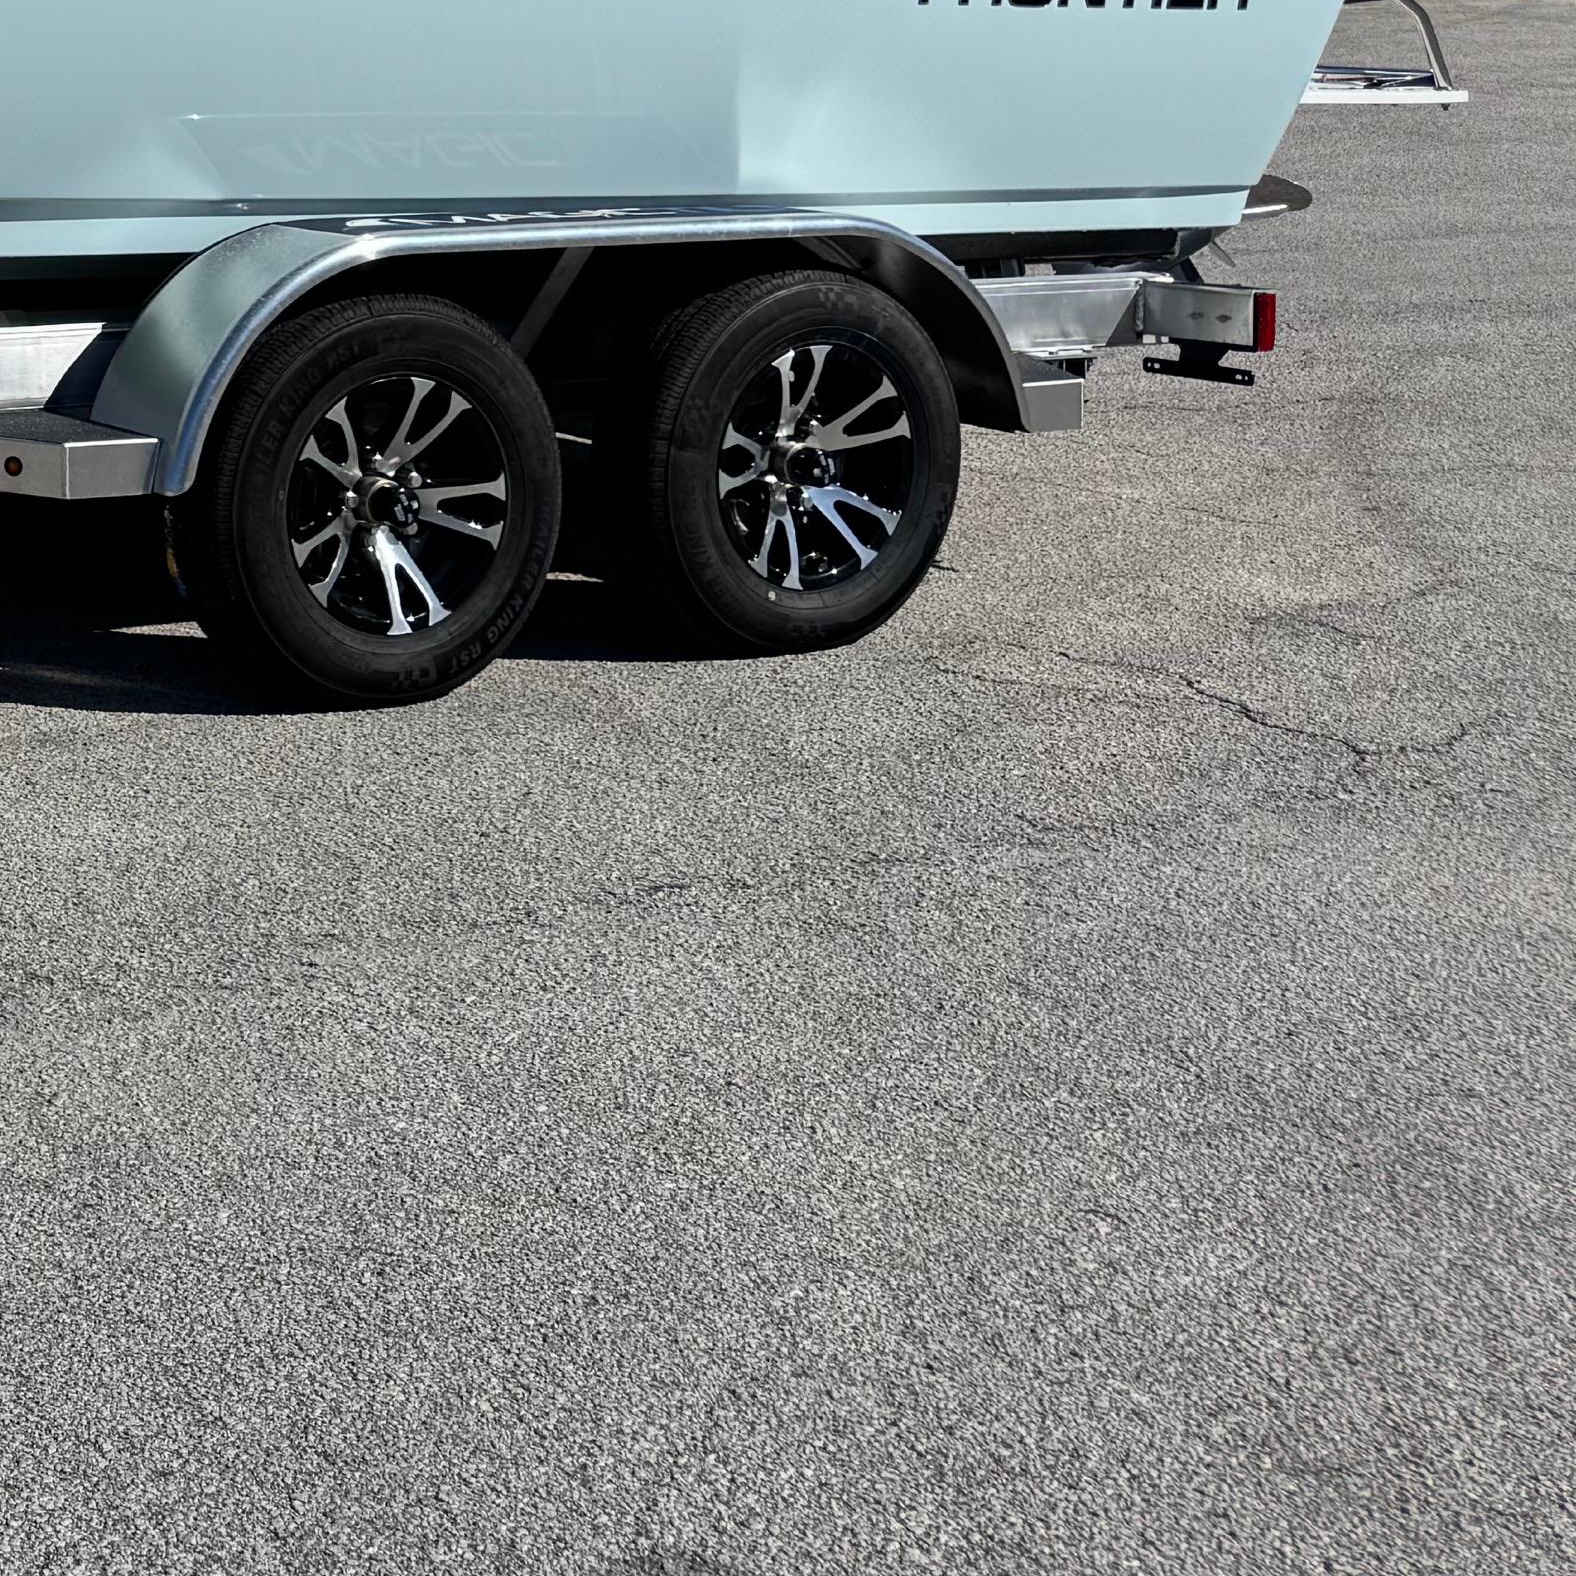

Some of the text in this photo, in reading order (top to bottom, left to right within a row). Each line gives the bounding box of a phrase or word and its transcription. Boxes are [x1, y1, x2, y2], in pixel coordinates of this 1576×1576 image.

[279, 366, 322, 418] KING
[486, 593, 523, 643] KING
[449, 639, 482, 675] RST
